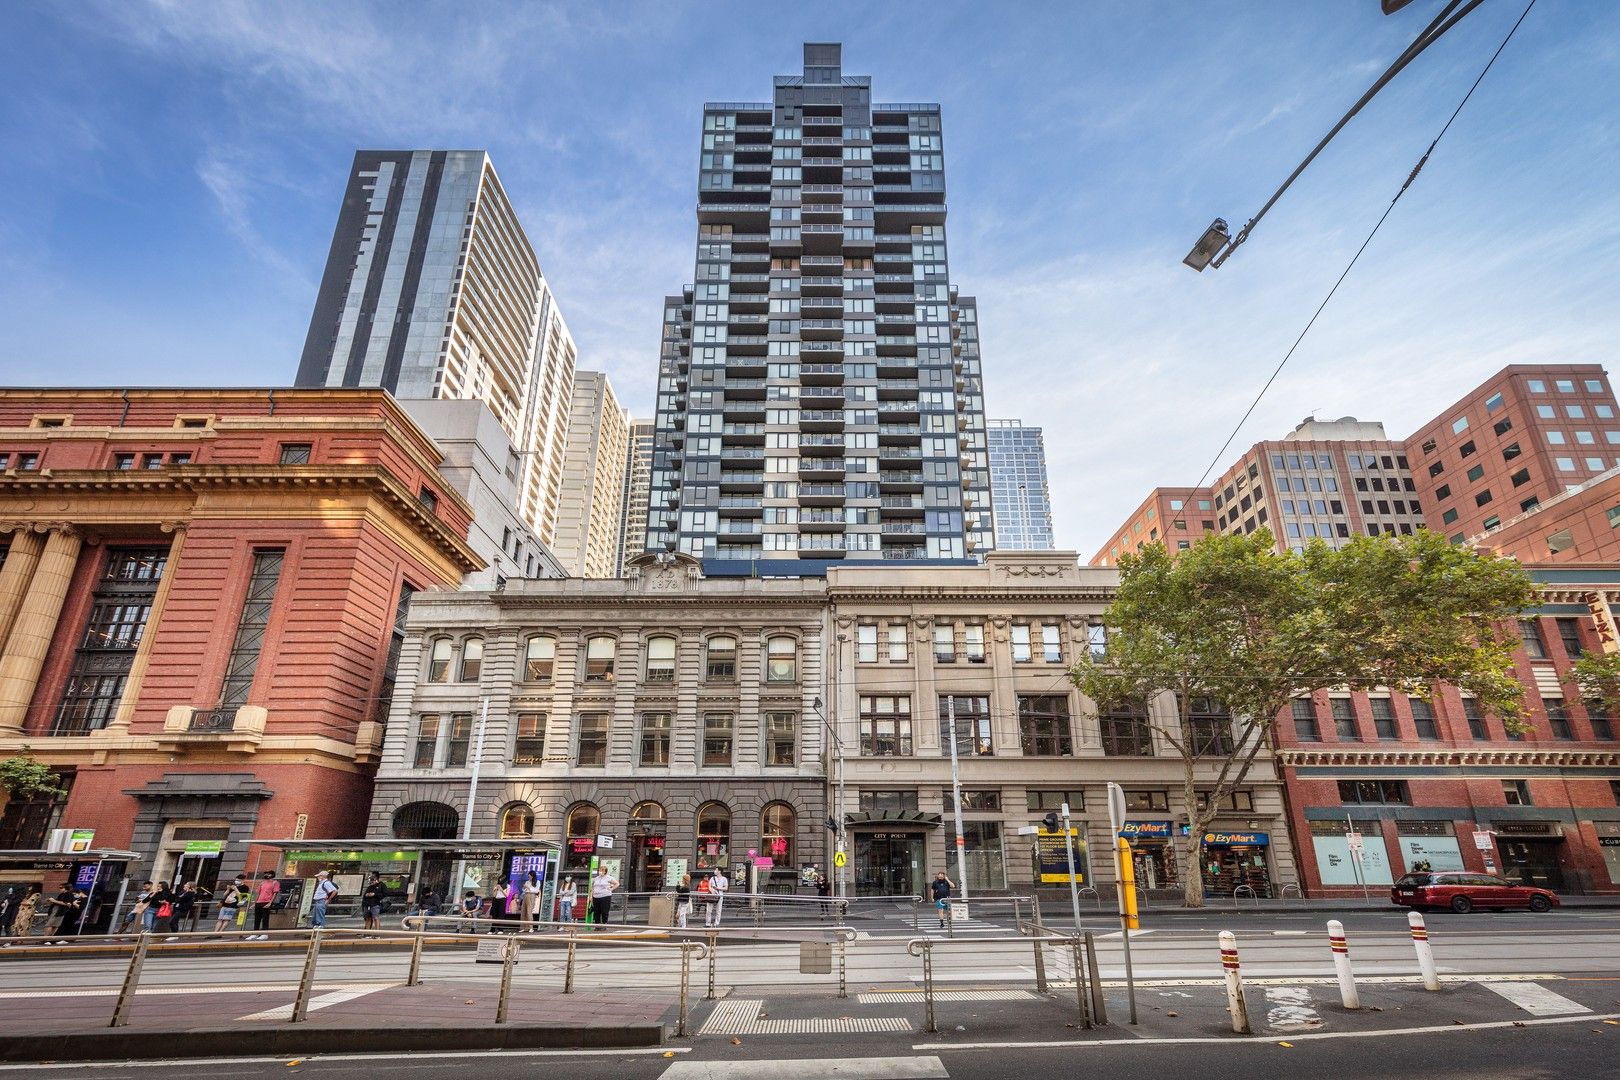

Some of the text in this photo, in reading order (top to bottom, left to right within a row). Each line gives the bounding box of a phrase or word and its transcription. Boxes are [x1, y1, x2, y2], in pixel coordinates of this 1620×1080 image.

[296, 816, 306, 839] BEWARE
[1124, 823, 1167, 834] EzyMart
[1215, 834, 1255, 844] EzyMart
[512, 856, 545, 864] acmi
[511, 864, 543, 872] acmi
